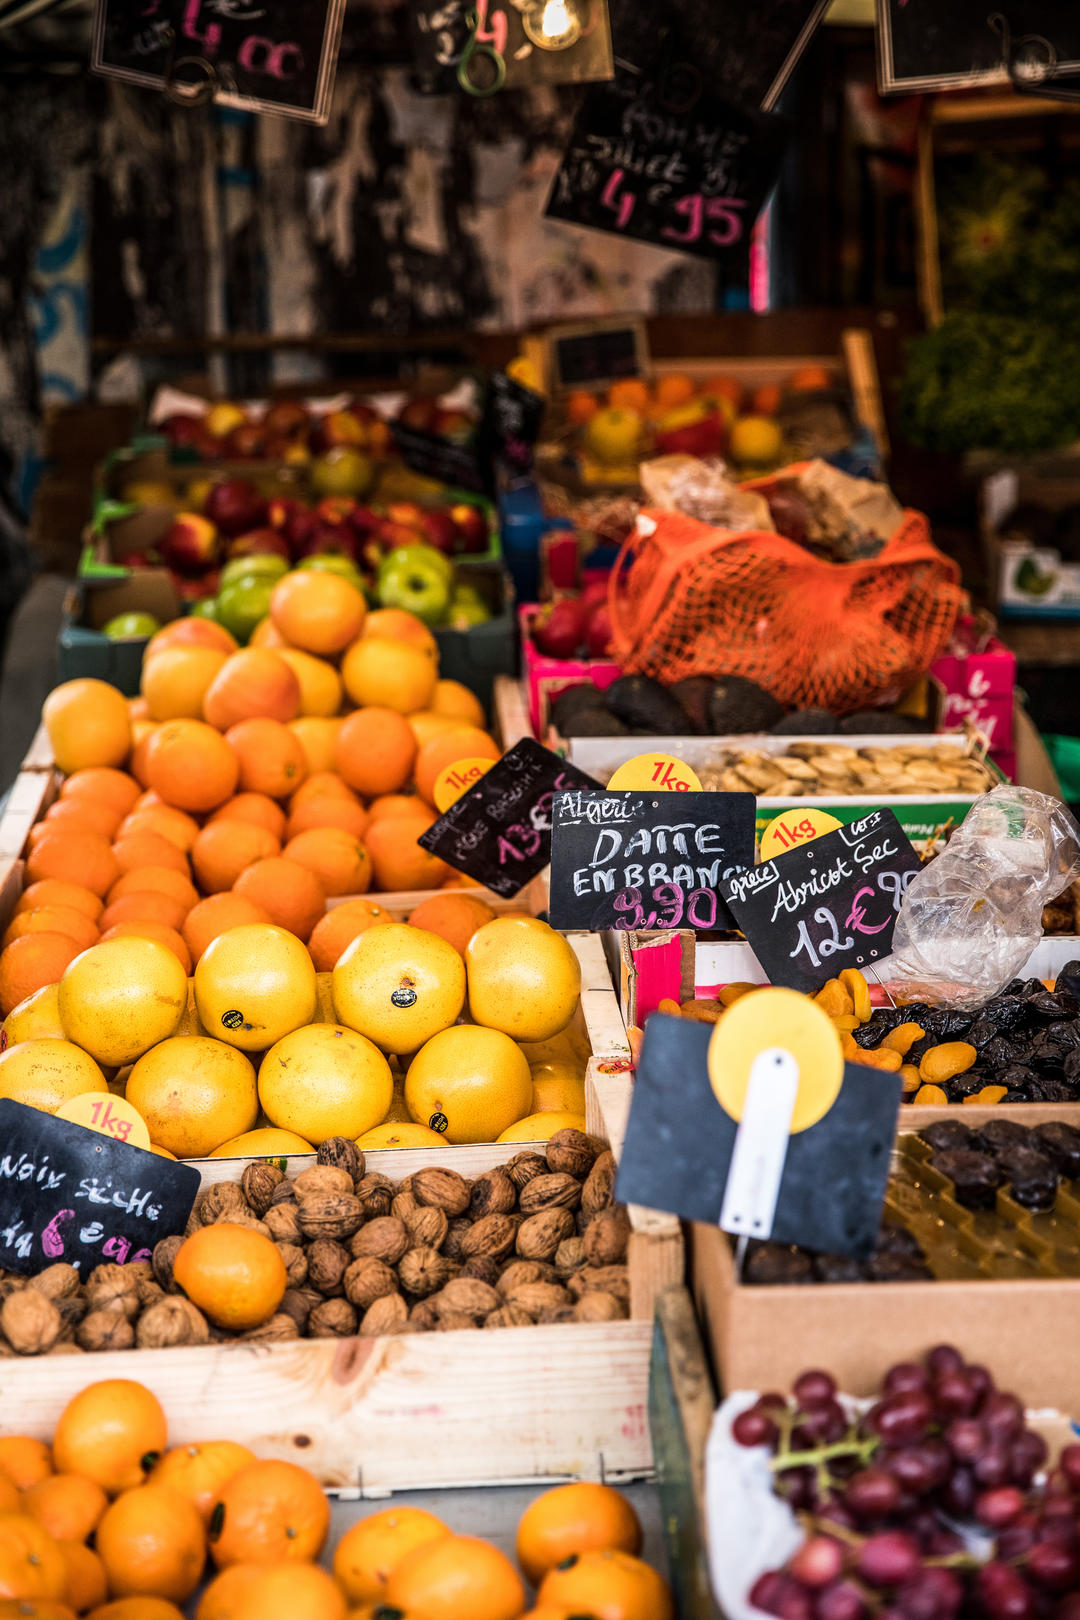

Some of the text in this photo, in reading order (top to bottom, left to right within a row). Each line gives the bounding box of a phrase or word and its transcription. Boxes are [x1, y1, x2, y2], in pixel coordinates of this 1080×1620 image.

[589, 823, 725, 868] DATTE
[772, 818, 817, 848] 1kg
[623, 859, 748, 889] BRAN
[771, 839, 898, 922] Abricot Sec
[90, 1101, 133, 1142] 1kg
